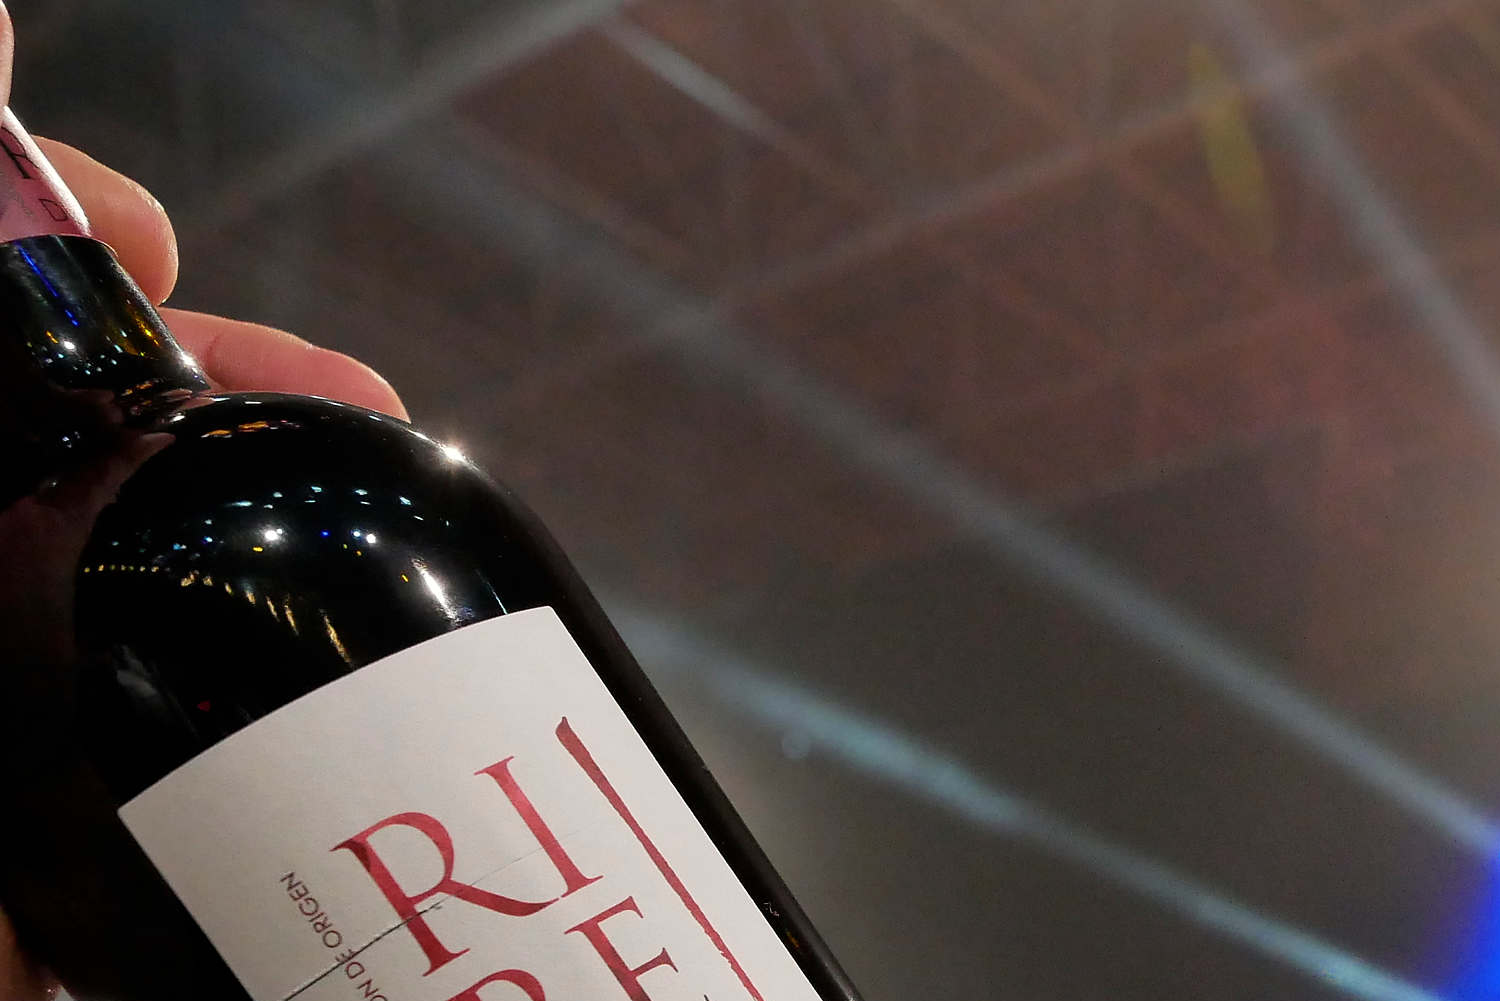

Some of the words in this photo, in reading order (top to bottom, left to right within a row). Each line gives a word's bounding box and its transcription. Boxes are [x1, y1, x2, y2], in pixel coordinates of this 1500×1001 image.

[328, 755, 604, 978] RI
[279, 871, 343, 949] ORIGEN
[333, 946, 369, 983] DE
